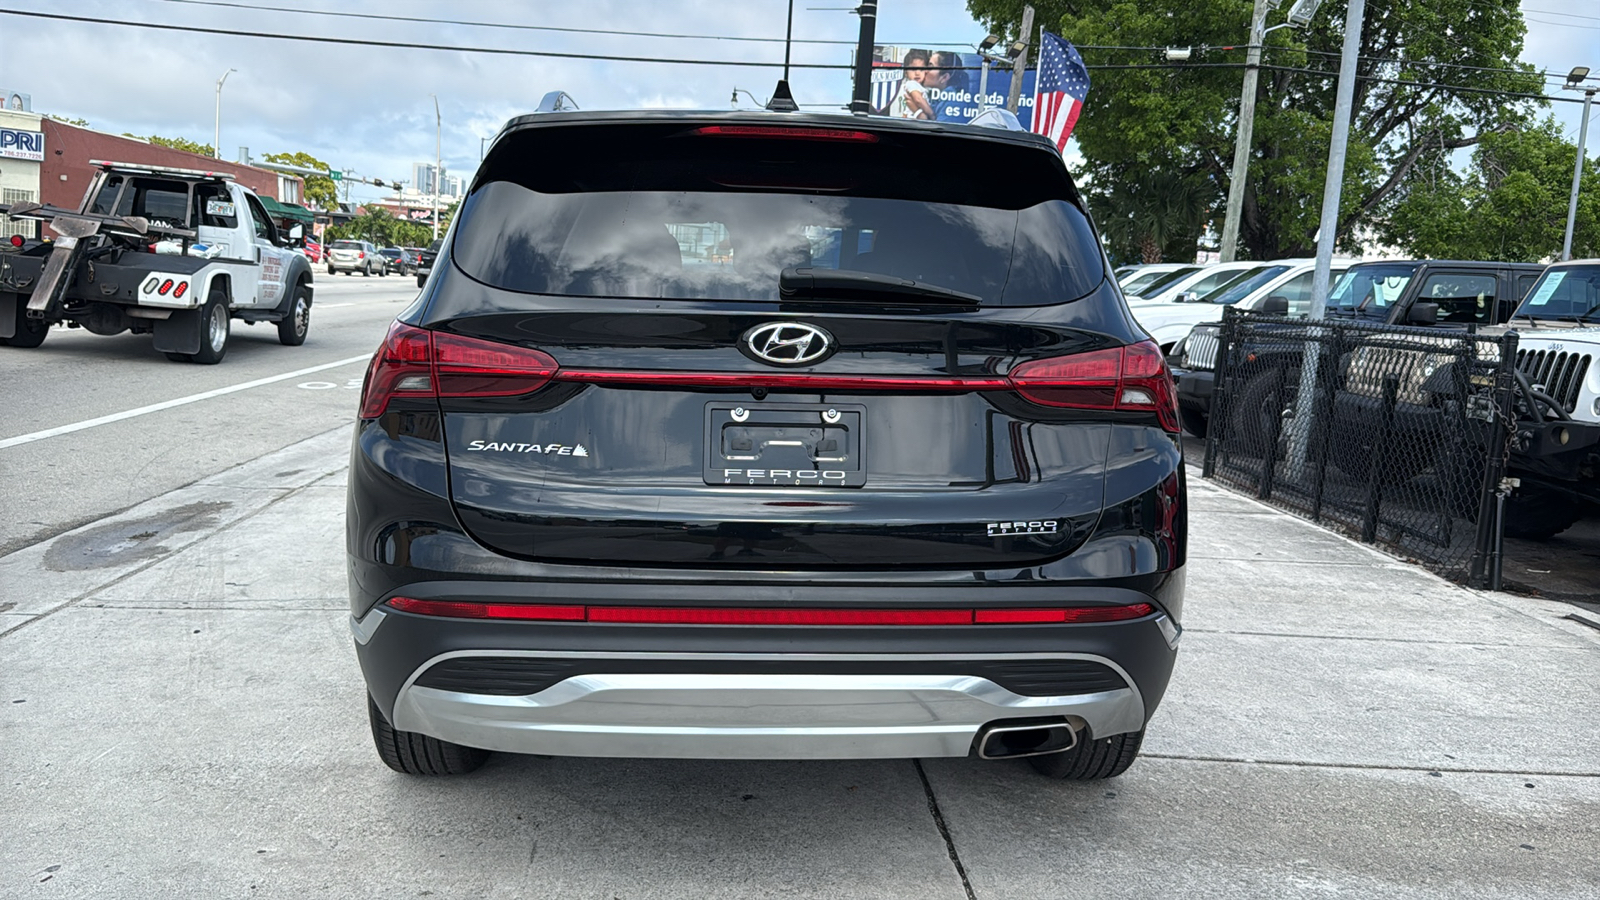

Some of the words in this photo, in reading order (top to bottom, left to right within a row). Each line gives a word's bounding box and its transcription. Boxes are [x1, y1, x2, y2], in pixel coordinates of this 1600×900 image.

[931, 88, 972, 103] Donde
[1007, 94, 1034, 107] ño
[945, 106, 960, 117] es
[725, 469, 845, 479] FERCO
